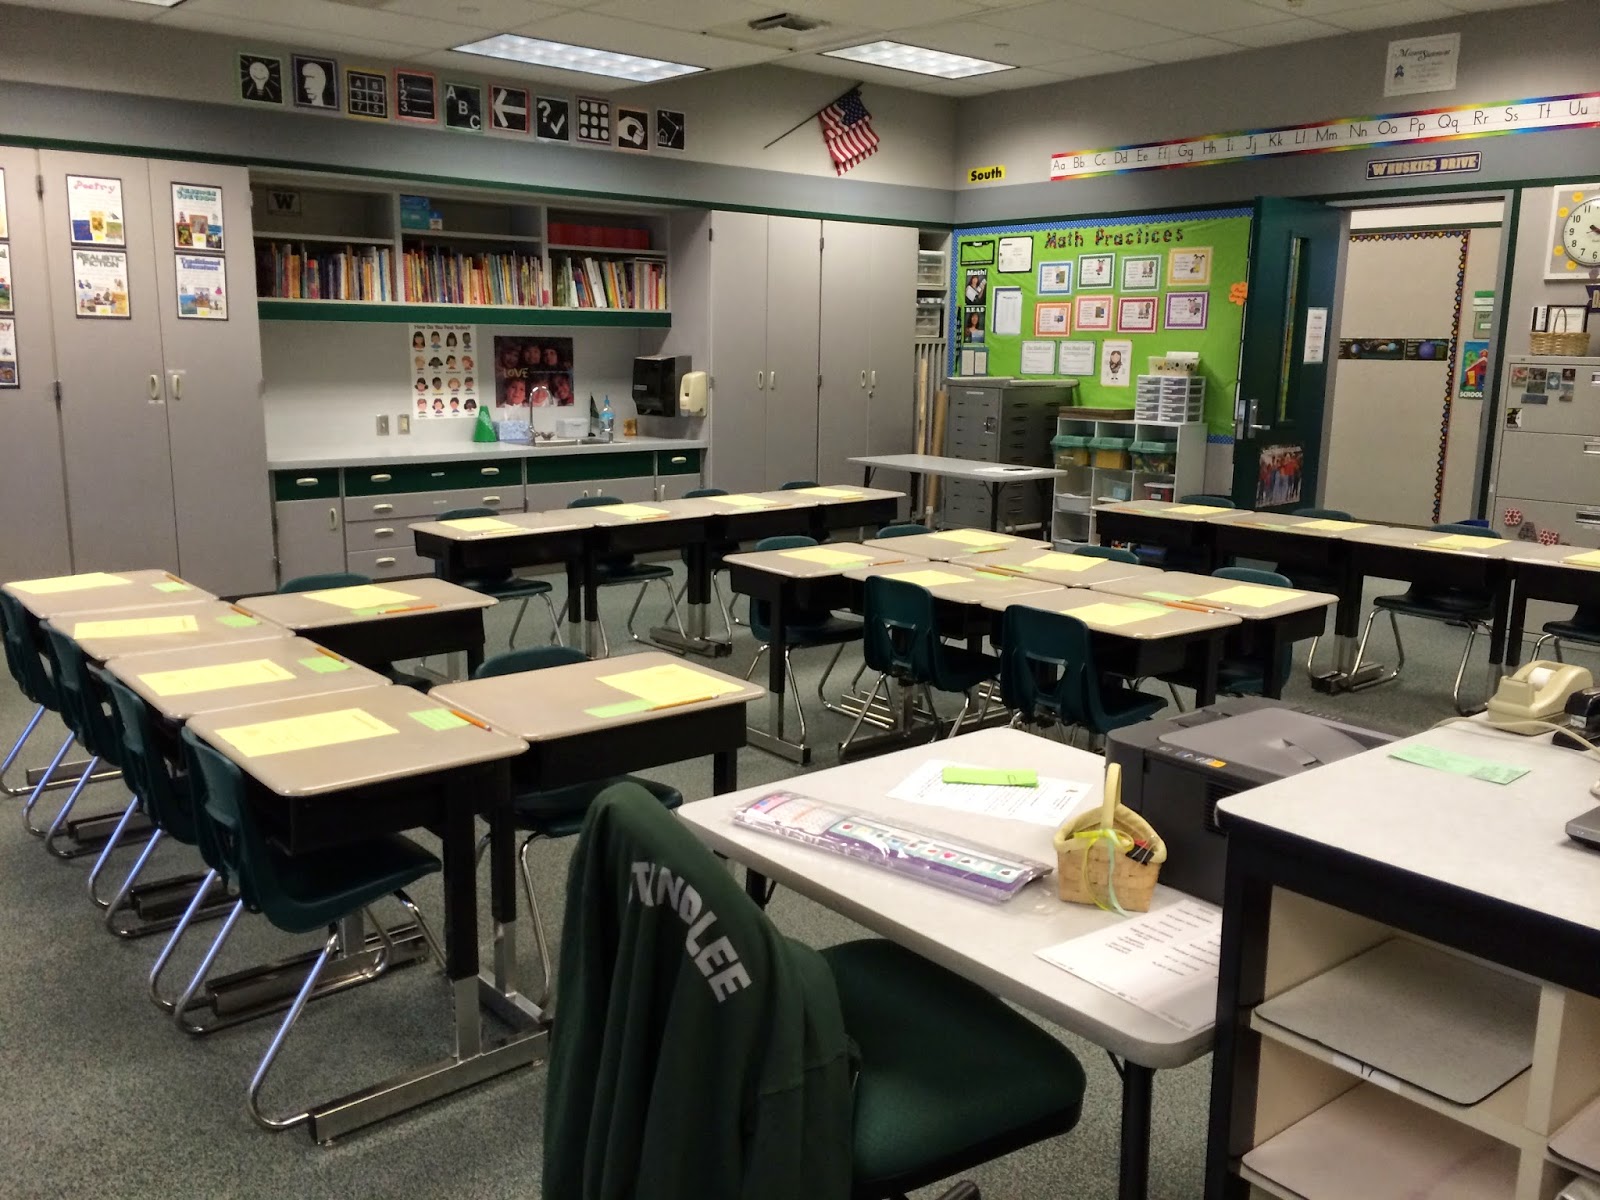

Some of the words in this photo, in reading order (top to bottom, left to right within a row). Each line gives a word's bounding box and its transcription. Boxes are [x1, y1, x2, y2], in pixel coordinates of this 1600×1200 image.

[447, 85, 457, 100] A
[458, 101, 468, 115] B
[469, 115, 480, 130] C
[1052, 159, 1066, 171] Aa
[1073, 156, 1085, 169] Bb
[1094, 154, 1106, 166] Cc
[1114, 151, 1128, 164] Dd
[1137, 149, 1149, 162] Ee
[1158, 146, 1168, 160] Ff
[1178, 145, 1194, 161] Gg
[1202, 141, 1217, 155] Hh
[1226, 139, 1234, 152] Ii
[1246, 136, 1257, 155] Jj
[1269, 134, 1283, 147] Kk
[1295, 130, 1306, 145] Ll
[1315, 128, 1338, 142] Mm
[1350, 125, 1368, 138] Nn
[1377, 120, 1398, 136] Oo
[1409, 118, 1426, 137] Pp
[1437, 114, 1459, 133] Qq
[1474, 111, 1489, 125] Rr
[1505, 107, 1519, 122] Ss
[1537, 103, 1551, 119] Tt
[1568, 101, 1588, 116] Uu
[1387, 159, 1437, 175] HUSKIES
[1440, 156, 1477, 170] DRIVE
[970, 167, 1002, 182] South
[73, 180, 116, 194] Poetry
[273, 193, 295, 210] W
[1584, 205, 1591, 213] 11
[1573, 214, 1581, 223] 10
[1044, 230, 1084, 249] Math
[1095, 225, 1184, 247] Practices
[1569, 228, 1575, 236] 9
[76, 252, 125, 263] REALISTIC
[1580, 248, 1586, 256] 7
[1592, 251, 1598, 259] 6
[82, 259, 119, 269] FICTION
[503, 367, 529, 378] LOVE
